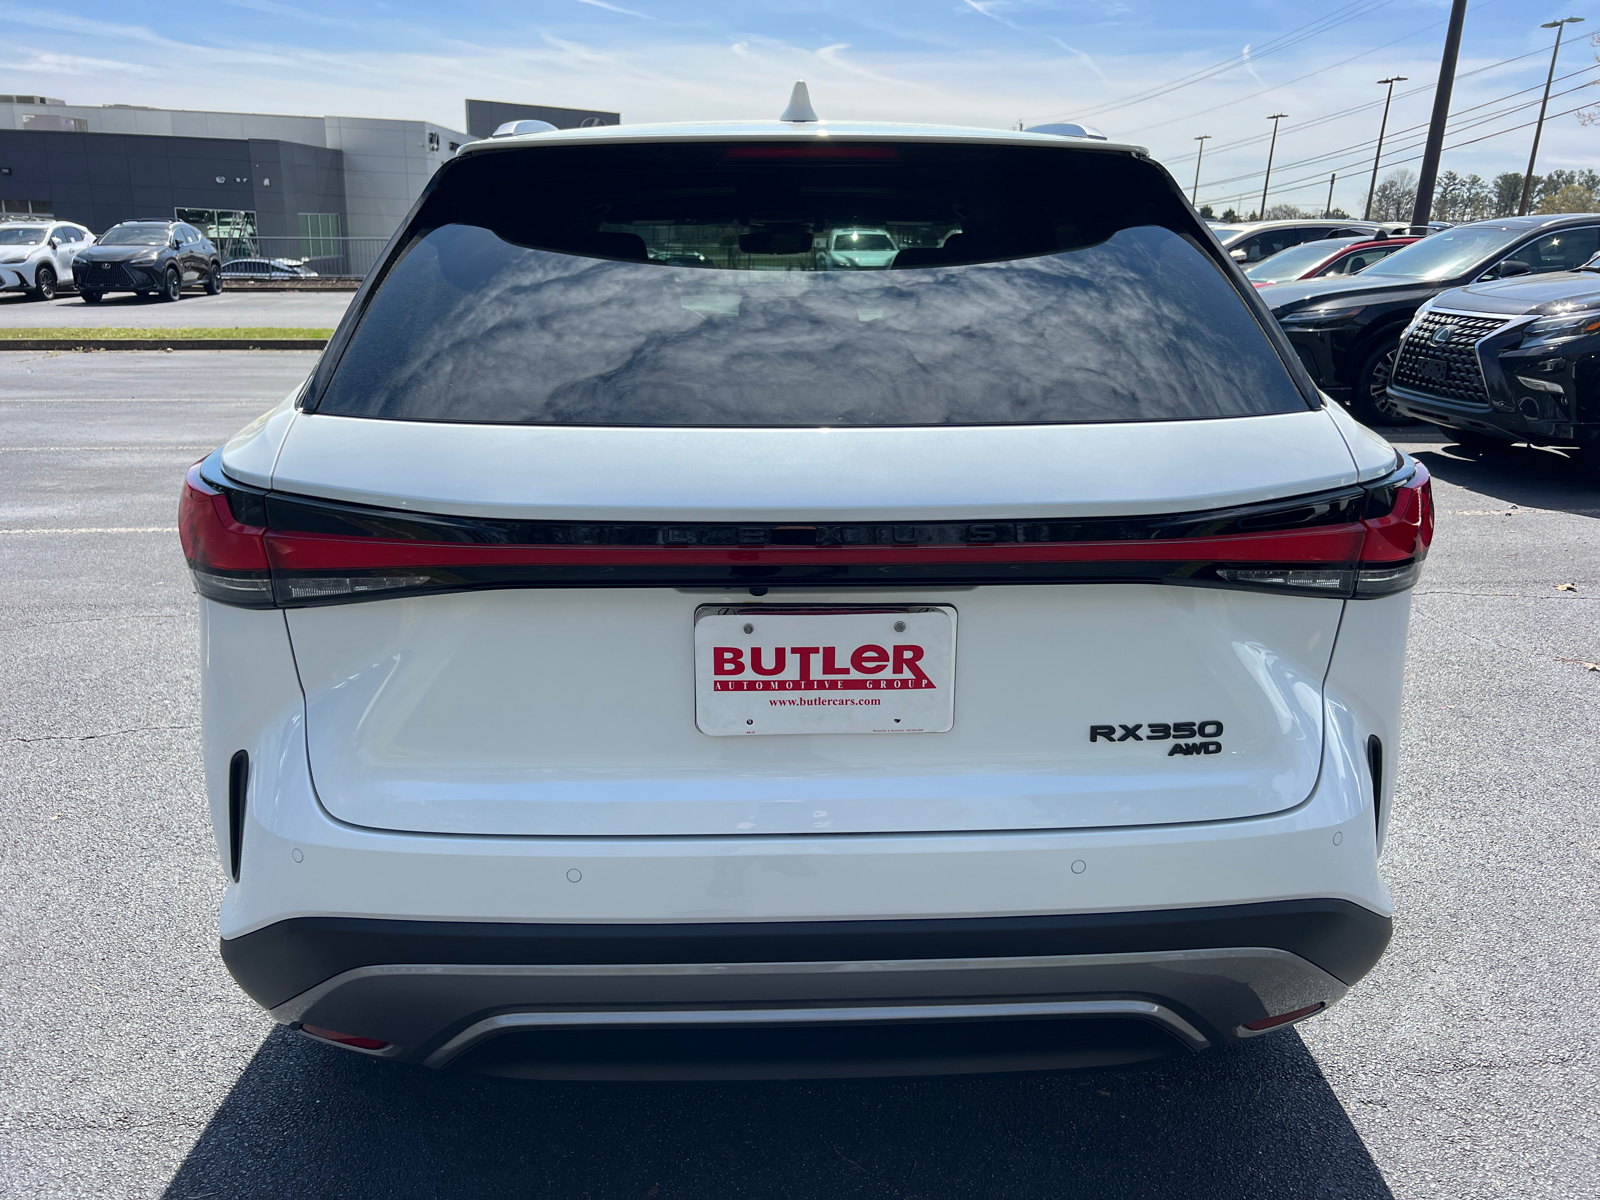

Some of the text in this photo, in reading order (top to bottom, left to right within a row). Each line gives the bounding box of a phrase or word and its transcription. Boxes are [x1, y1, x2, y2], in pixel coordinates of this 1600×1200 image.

[662, 523, 997, 546] LEXUS
[715, 679, 928, 690] AUTOMOTIVE GROUP
[768, 696, 881, 707] www.butlercars.com
[1167, 741, 1223, 757] AWD
